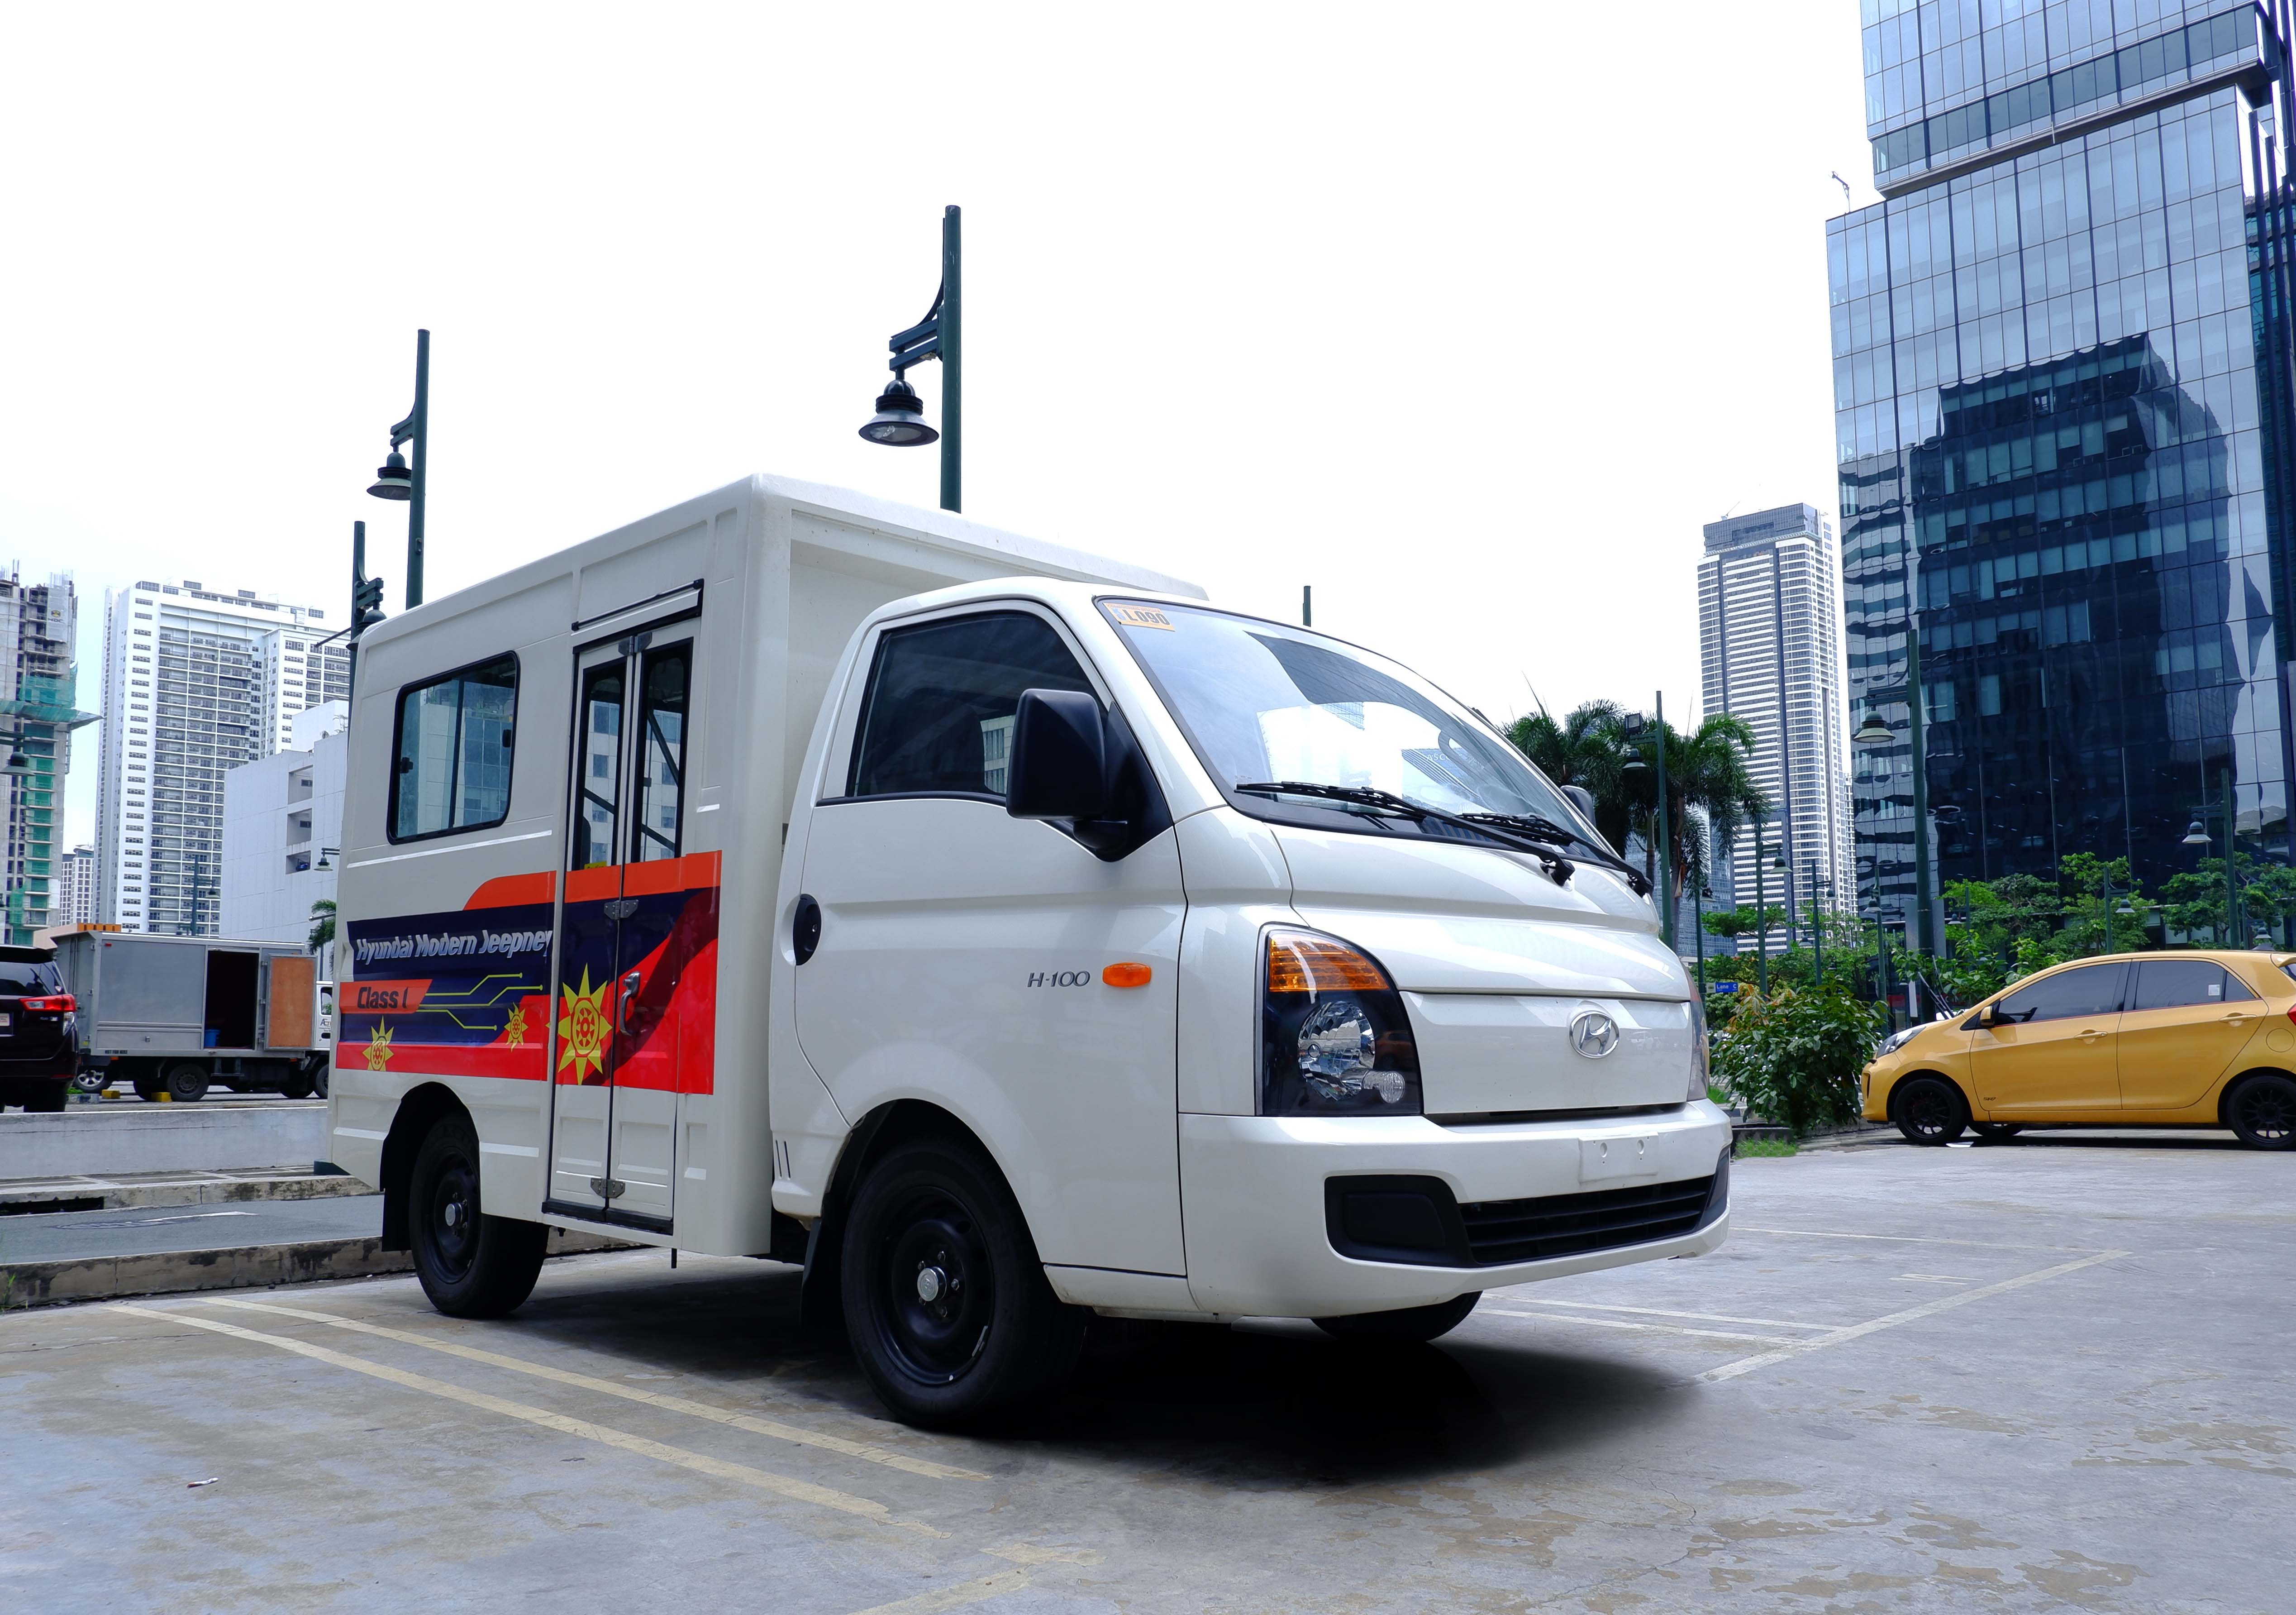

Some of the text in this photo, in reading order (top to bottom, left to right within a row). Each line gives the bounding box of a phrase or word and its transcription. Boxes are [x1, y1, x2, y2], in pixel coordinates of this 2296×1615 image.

[1122, 609, 1170, 625] L090
[356, 929, 553, 965] Hyundai Modern Jeepney
[1027, 970, 1091, 988] H-100
[357, 986, 399, 1009] Class
